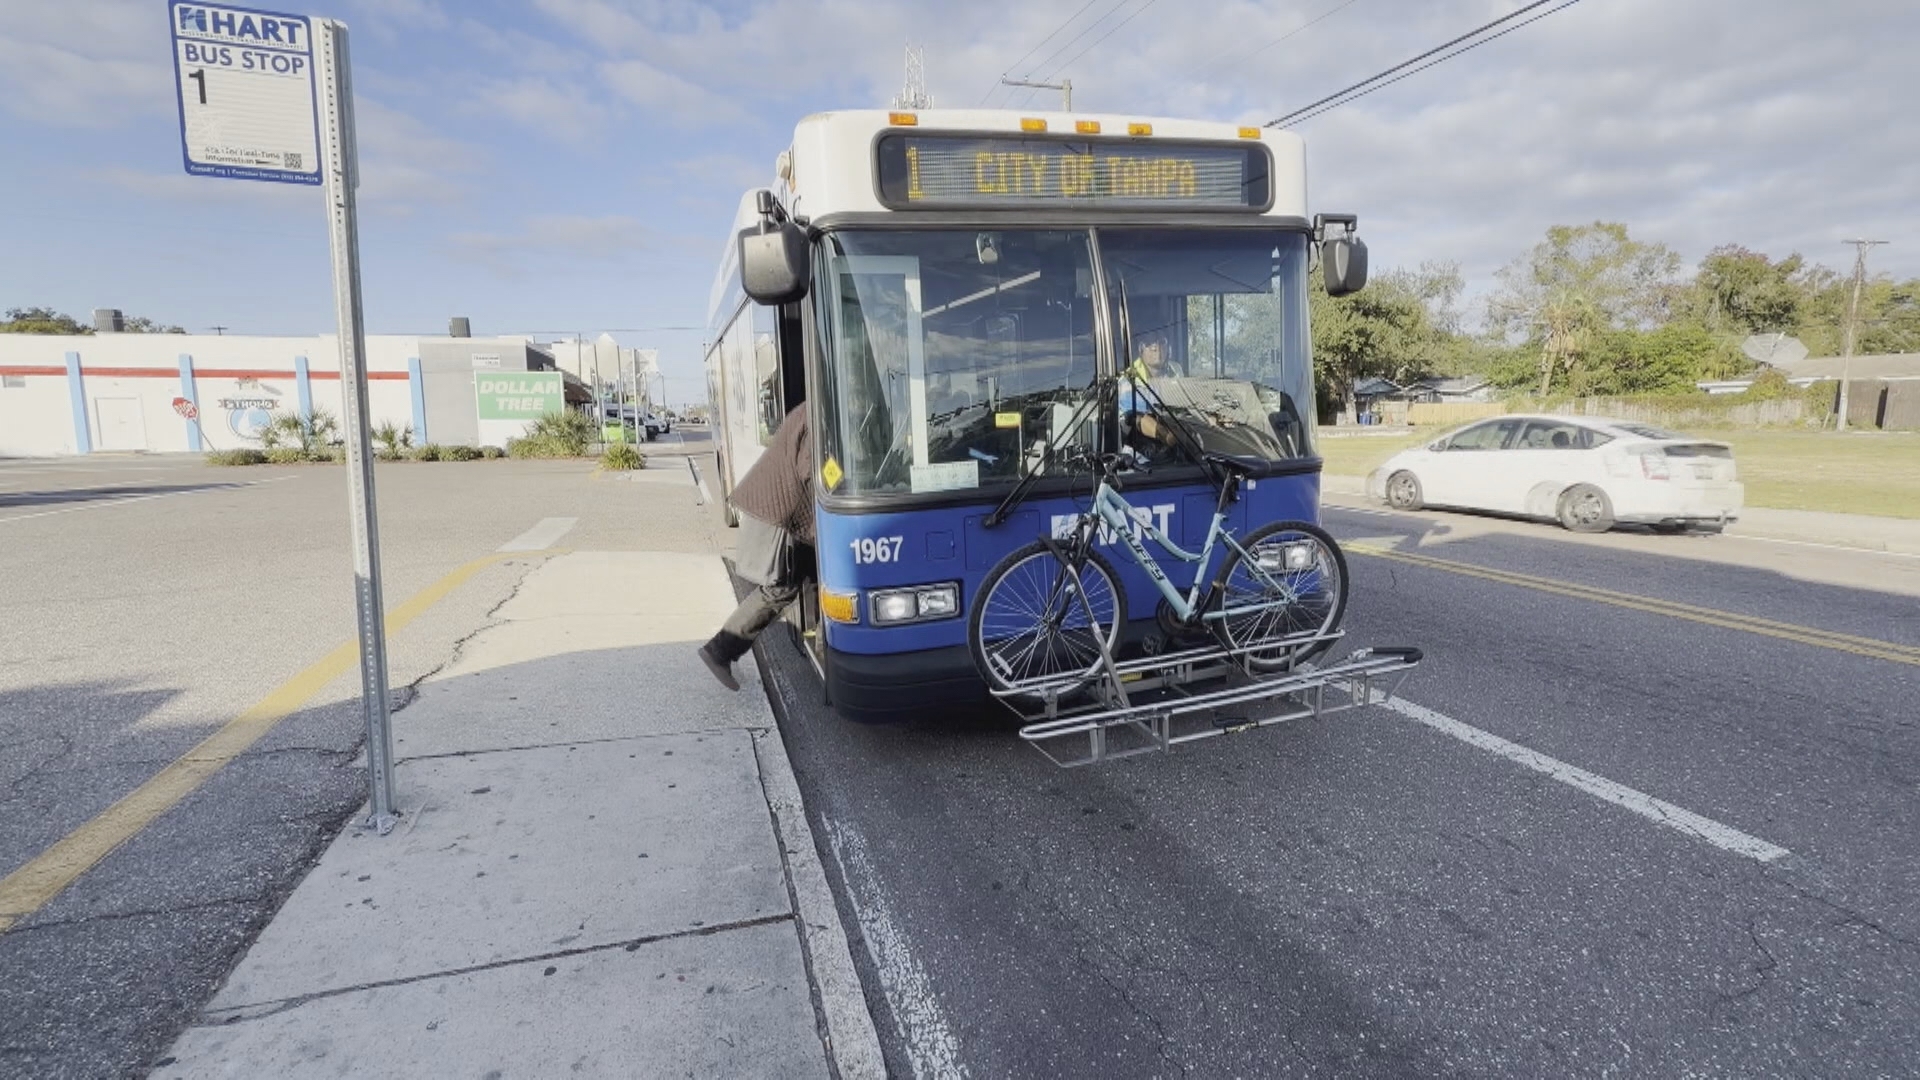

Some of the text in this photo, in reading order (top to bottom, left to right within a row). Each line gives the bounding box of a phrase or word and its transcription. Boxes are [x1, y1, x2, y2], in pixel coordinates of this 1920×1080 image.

[211, 11, 302, 44] HART
[185, 43, 304, 74] BUS STOP
[188, 69, 207, 104] 1
[976, 152, 1195, 196] CITY OF TAMPA
[480, 380, 559, 394] DOLLAR
[496, 397, 544, 411] TREE
[849, 536, 904, 564] 1967
